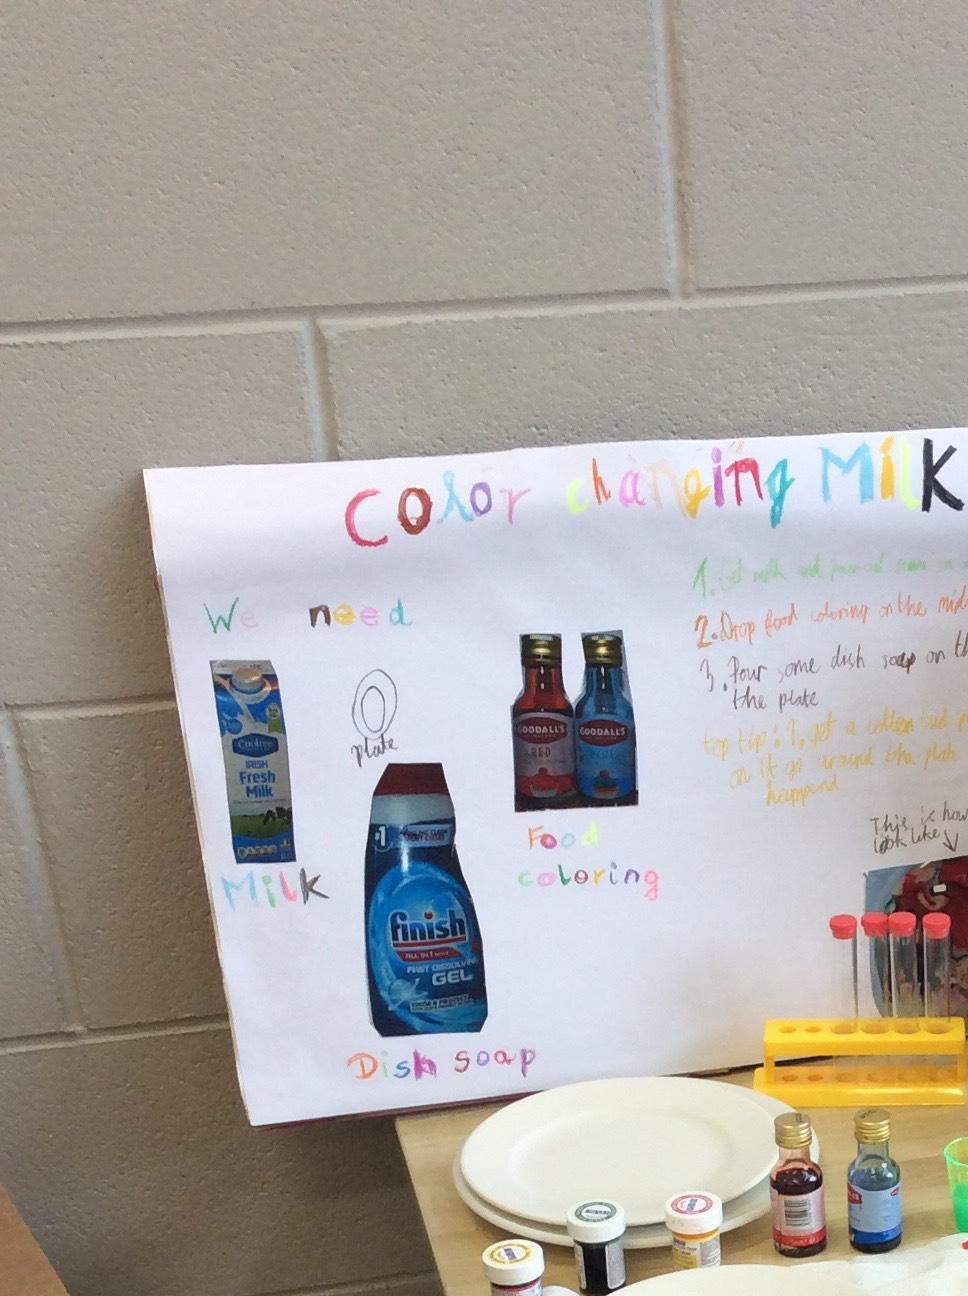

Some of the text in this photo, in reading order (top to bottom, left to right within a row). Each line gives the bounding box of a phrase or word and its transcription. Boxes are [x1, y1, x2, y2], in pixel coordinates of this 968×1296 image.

[344, 470, 530, 547] Color
[564, 447, 796, 528] changing
[204, 597, 413, 633] We need
[830, 644, 866, 669] dish
[733, 685, 819, 713] the plate
[580, 727, 626, 736] GOODALL'S
[352, 738, 399, 767] plate
[239, 770, 276, 784] Fresh
[245, 785, 274, 798] Milk
[942, 801, 968, 822] how
[529, 821, 598, 849] Food
[518, 862, 660, 900] coloring
[390, 909, 466, 941] finish
[432, 970, 472, 986] GEL
[454, 1048, 537, 1077] soap
